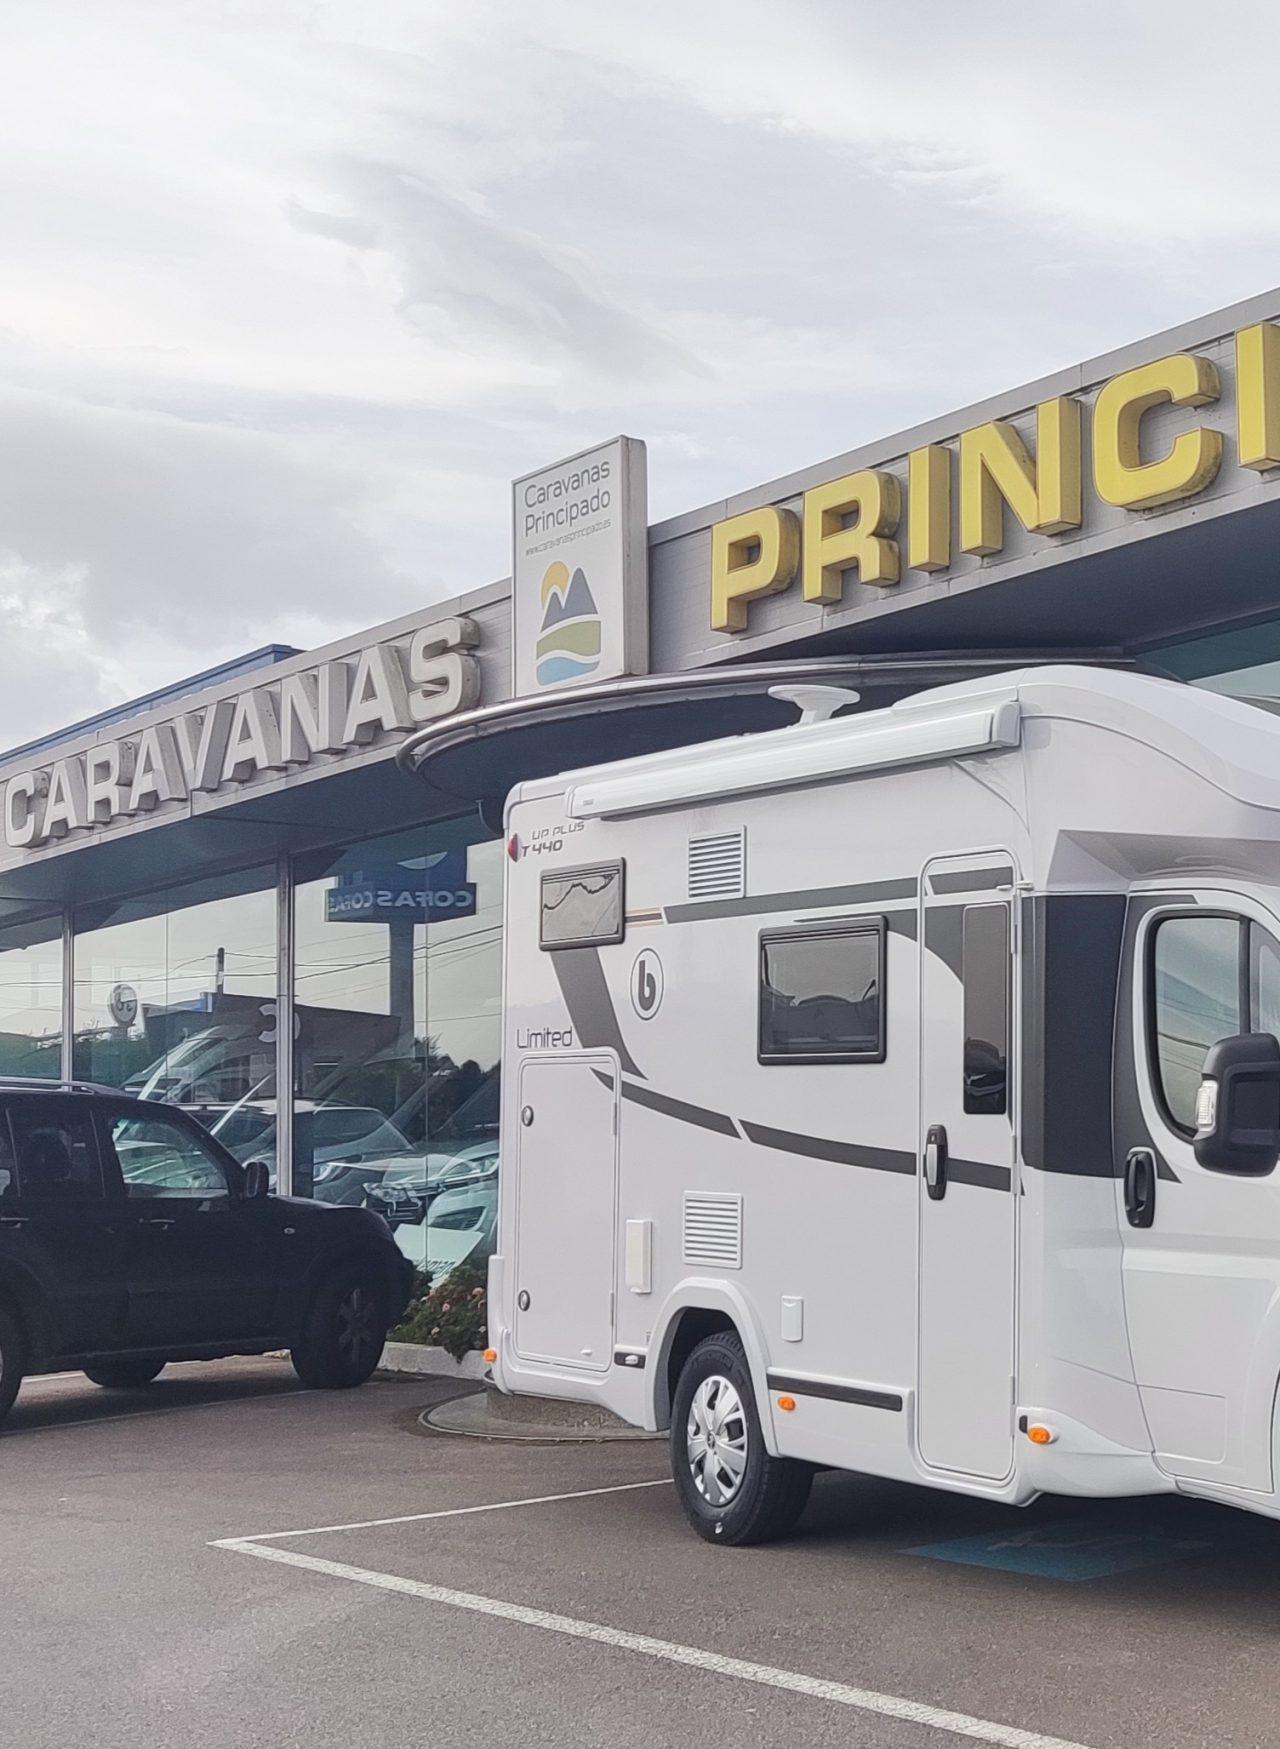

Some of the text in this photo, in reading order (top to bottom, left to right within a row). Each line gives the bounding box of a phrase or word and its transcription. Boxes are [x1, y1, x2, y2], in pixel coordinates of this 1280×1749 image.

[524, 461, 610, 508] Caravanas
[525, 487, 611, 538] Principado
[4, 616, 481, 848] CARAVANAS
[532, 821, 584, 840] UP PLUS
[516, 1026, 573, 1049] Limited
